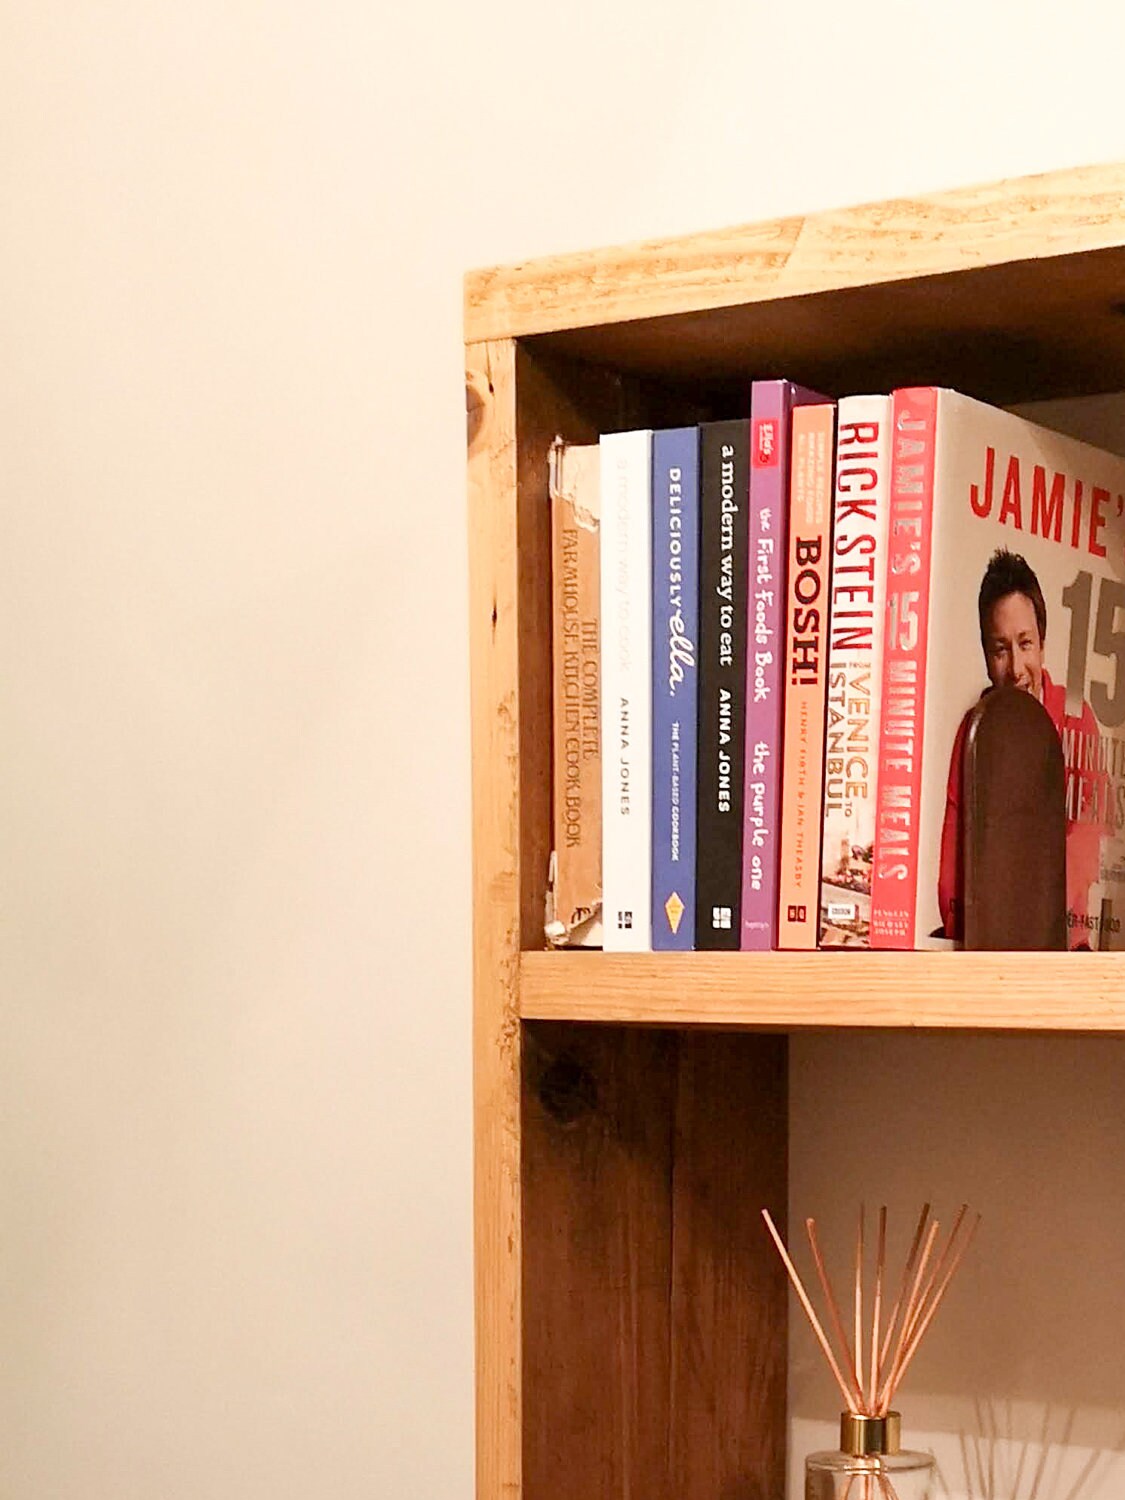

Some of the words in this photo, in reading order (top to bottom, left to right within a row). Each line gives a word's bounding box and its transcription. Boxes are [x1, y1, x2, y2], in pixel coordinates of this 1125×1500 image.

[721, 445, 735, 458] a
[836, 422, 879, 524] RICK
[720, 461, 739, 551] modern
[759, 507, 773, 532] the
[891, 410, 927, 574] JAMIE'S
[669, 468, 682, 609] DELICIOUSLY
[756, 539, 774, 584] First
[562, 529, 578, 645] FARMHOUSE
[716, 555, 734, 600] way
[832, 535, 876, 650] STEIN
[582, 618, 598, 652] THE
[719, 606, 735, 628] to
[791, 535, 822, 685] BOSH!
[888, 592, 919, 651] 15
[719, 633, 734, 666] eat
[753, 652, 773, 702] Book
[564, 652, 580, 732] KITCHEN
[582, 661, 598, 760] COMPLETE
[718, 688, 731, 745] ANNA
[882, 660, 917, 773] MINUTE
[620, 698, 630, 749] ANNA
[672, 722, 680, 740] THE
[799, 701, 808, 745] HENRY
[826, 662, 846, 817] ISTANBUL
[845, 673, 871, 799] VENICE
[565, 738, 581, 792] COOK
[620, 758, 630, 816] JONES
[718, 750, 731, 813] JONES
[752, 742, 771, 775] the
[565, 797, 581, 848] BOOK
[671, 806, 680, 861] COOKBOOK
[748, 782, 770, 847] purple
[844, 803, 853, 817] TO
[877, 785, 912, 880] MEALS
[751, 855, 764, 890] one
